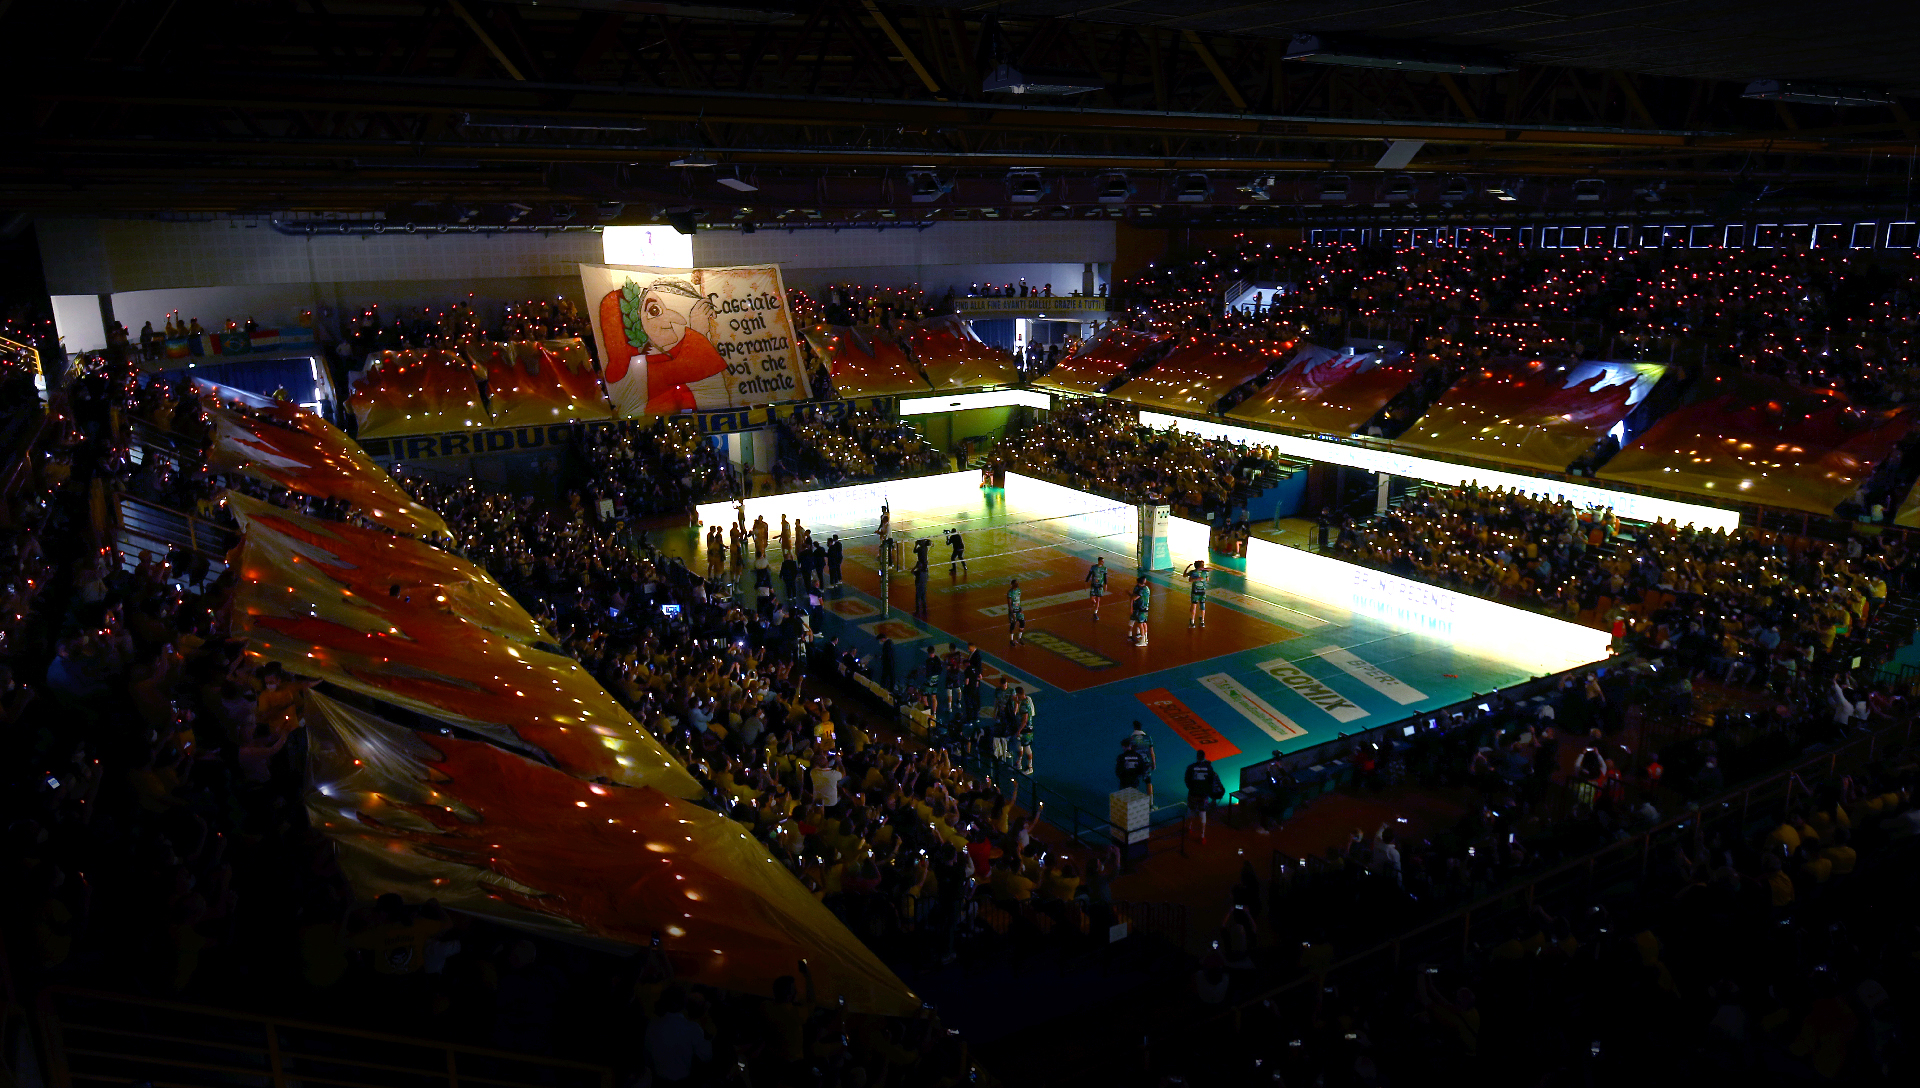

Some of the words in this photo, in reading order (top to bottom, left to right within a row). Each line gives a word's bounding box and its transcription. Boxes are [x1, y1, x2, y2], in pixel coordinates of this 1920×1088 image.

[970, 301, 986, 310] ALLA
[988, 301, 1001, 310] FINE
[1003, 300, 1026, 310] AVANTI
[1054, 299, 1077, 309] GRAZIE
[729, 312, 767, 335] ogni
[717, 336, 790, 359] speranza
[726, 358, 752, 376] voi
[761, 355, 787, 372] che
[738, 373, 795, 395] entrate
[1269, 667, 1357, 712] COMIX
